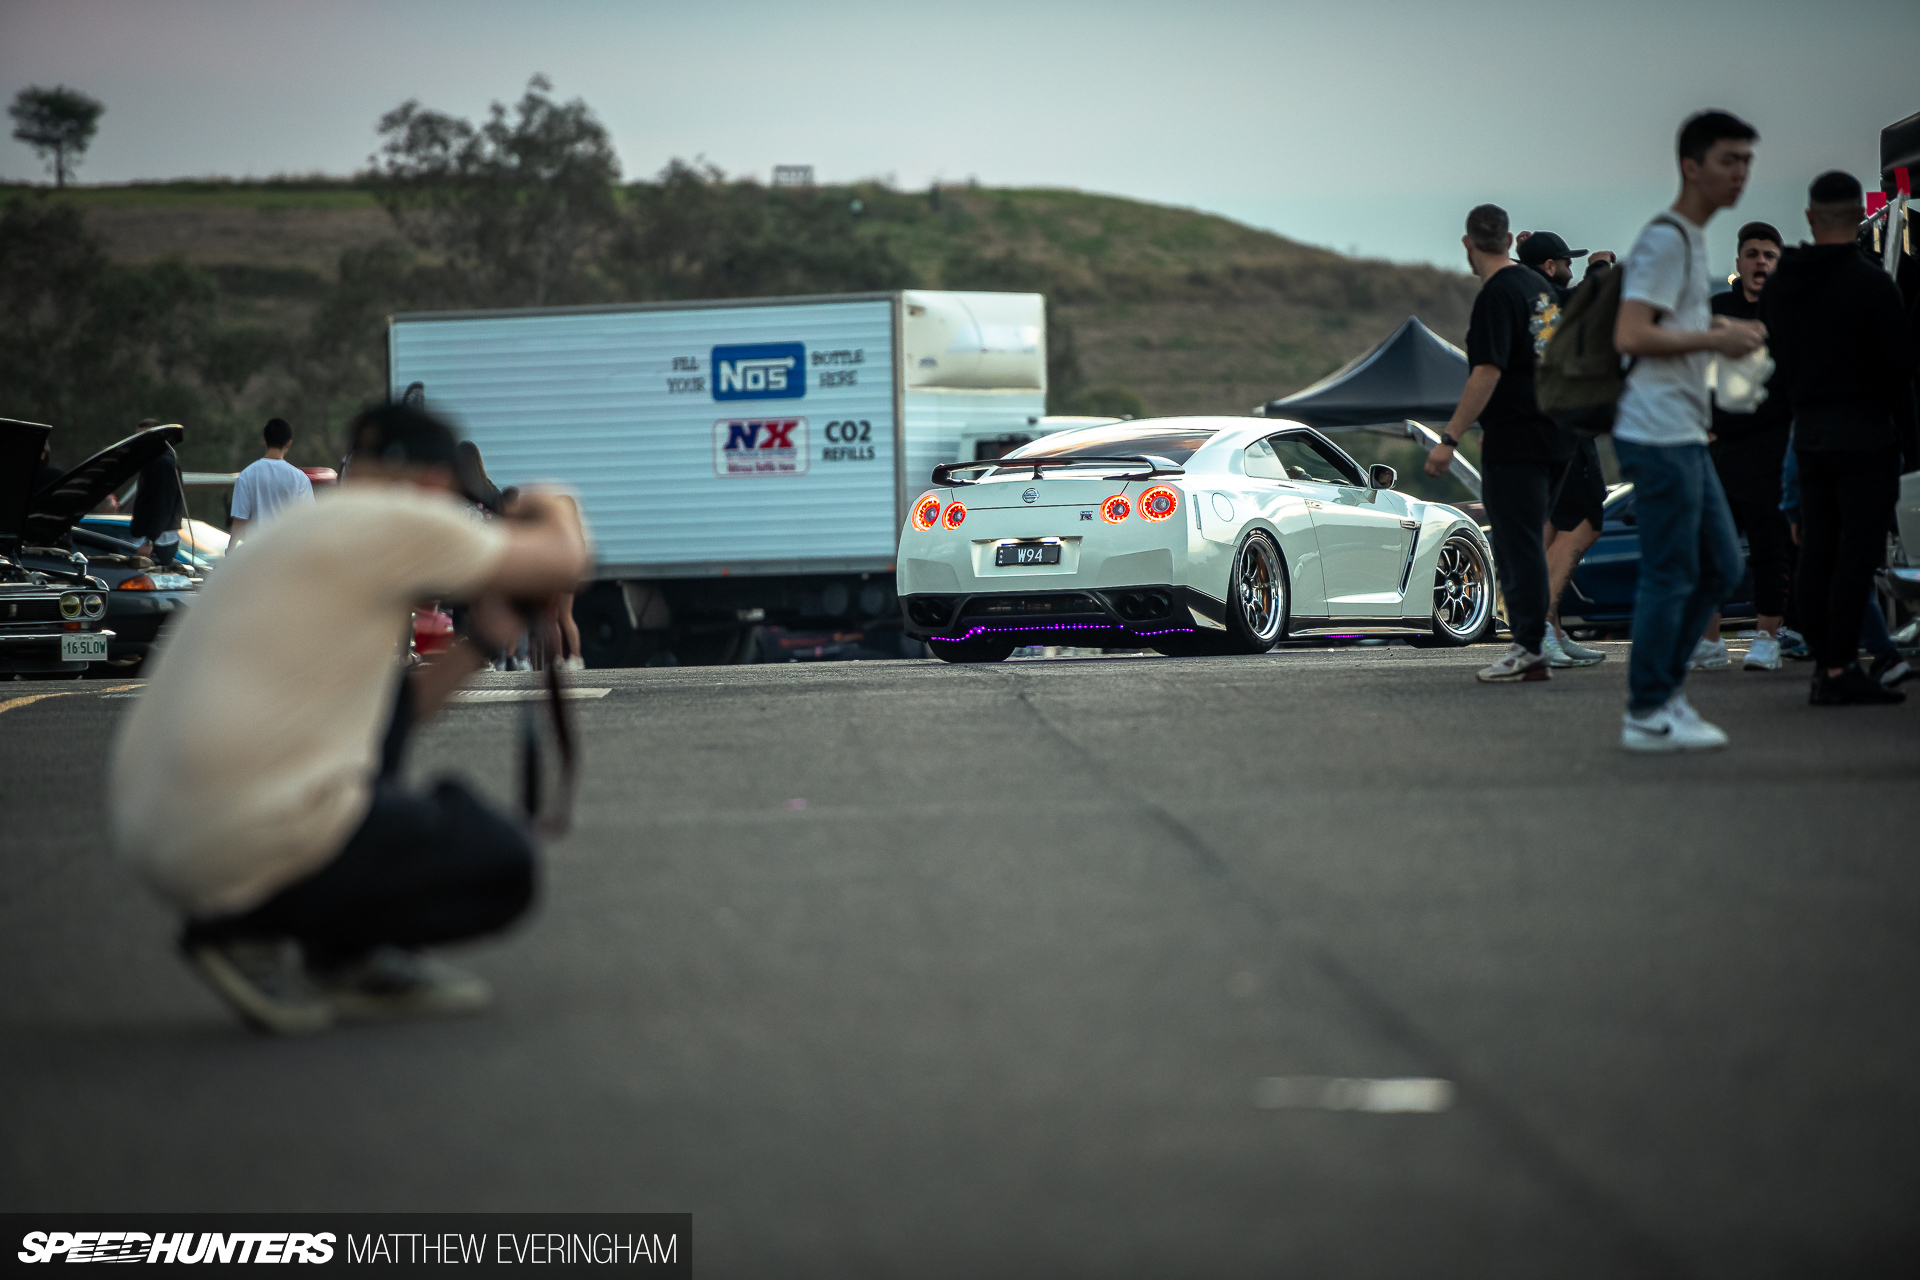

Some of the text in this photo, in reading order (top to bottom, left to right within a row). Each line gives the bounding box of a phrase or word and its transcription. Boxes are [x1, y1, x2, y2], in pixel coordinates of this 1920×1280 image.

[719, 356, 796, 392] NOS
[723, 421, 798, 450] NX
[825, 420, 872, 443] CO2
[822, 446, 875, 461] REFILLS
[1018, 548, 1043, 563] W94
